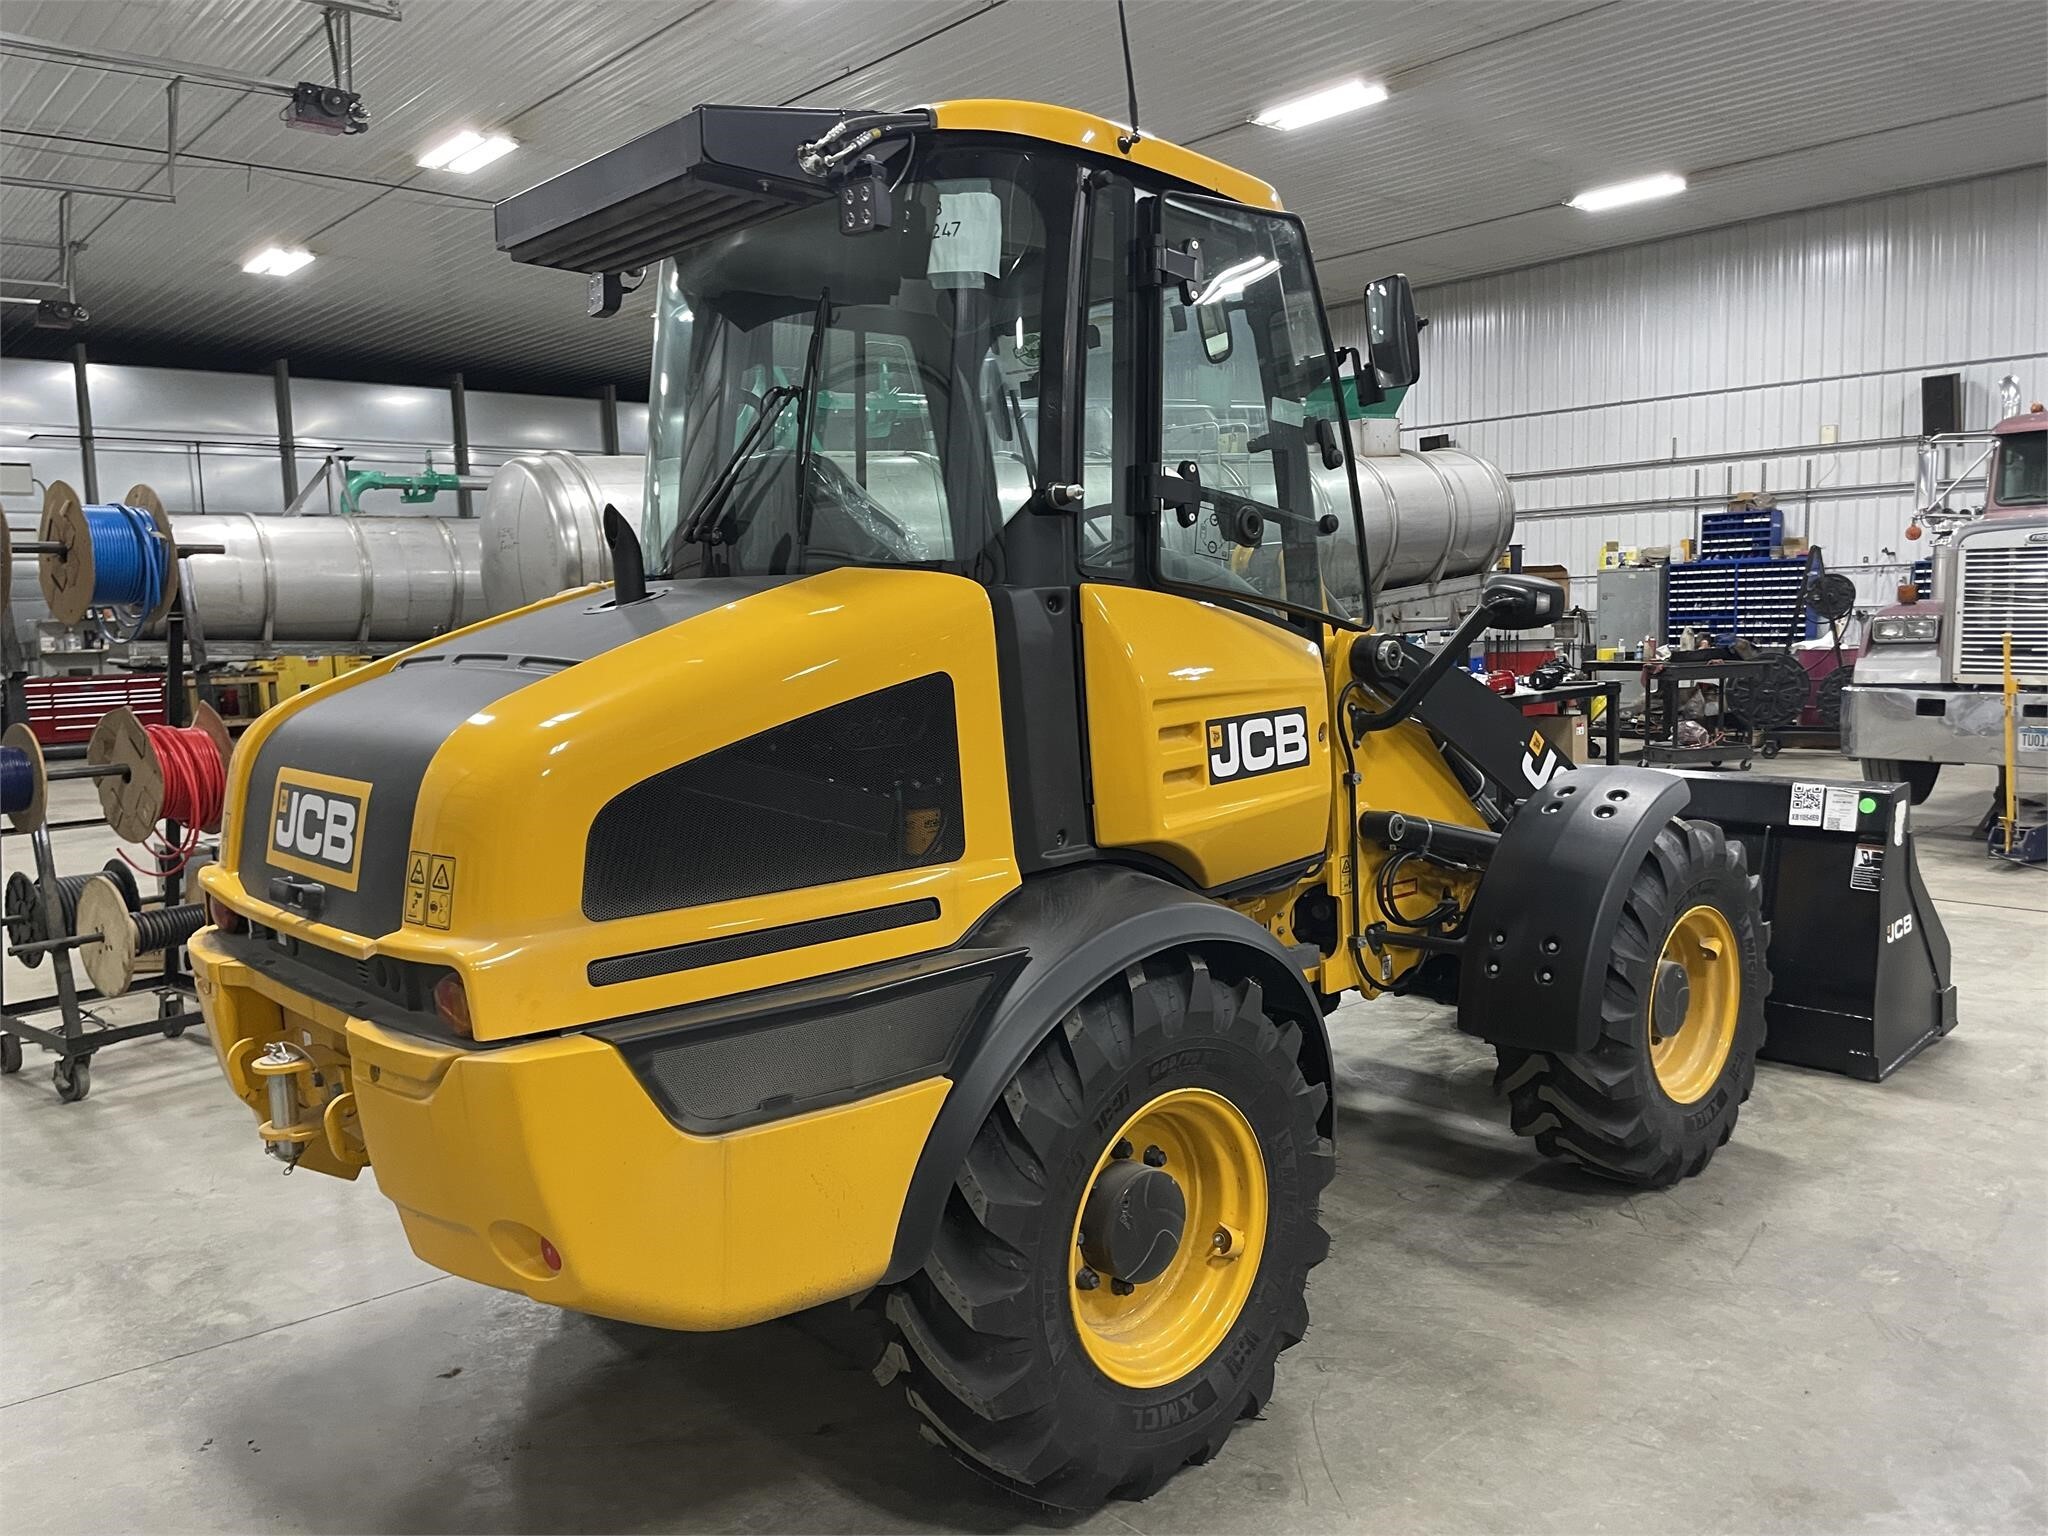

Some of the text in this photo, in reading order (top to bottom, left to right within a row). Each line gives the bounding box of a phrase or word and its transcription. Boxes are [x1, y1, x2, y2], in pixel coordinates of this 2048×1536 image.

[1211, 713, 1308, 778] JCB
[276, 791, 356, 865] JCB
[1886, 914, 1913, 944] JCB
[1132, 1391, 1199, 1432] XMCL
